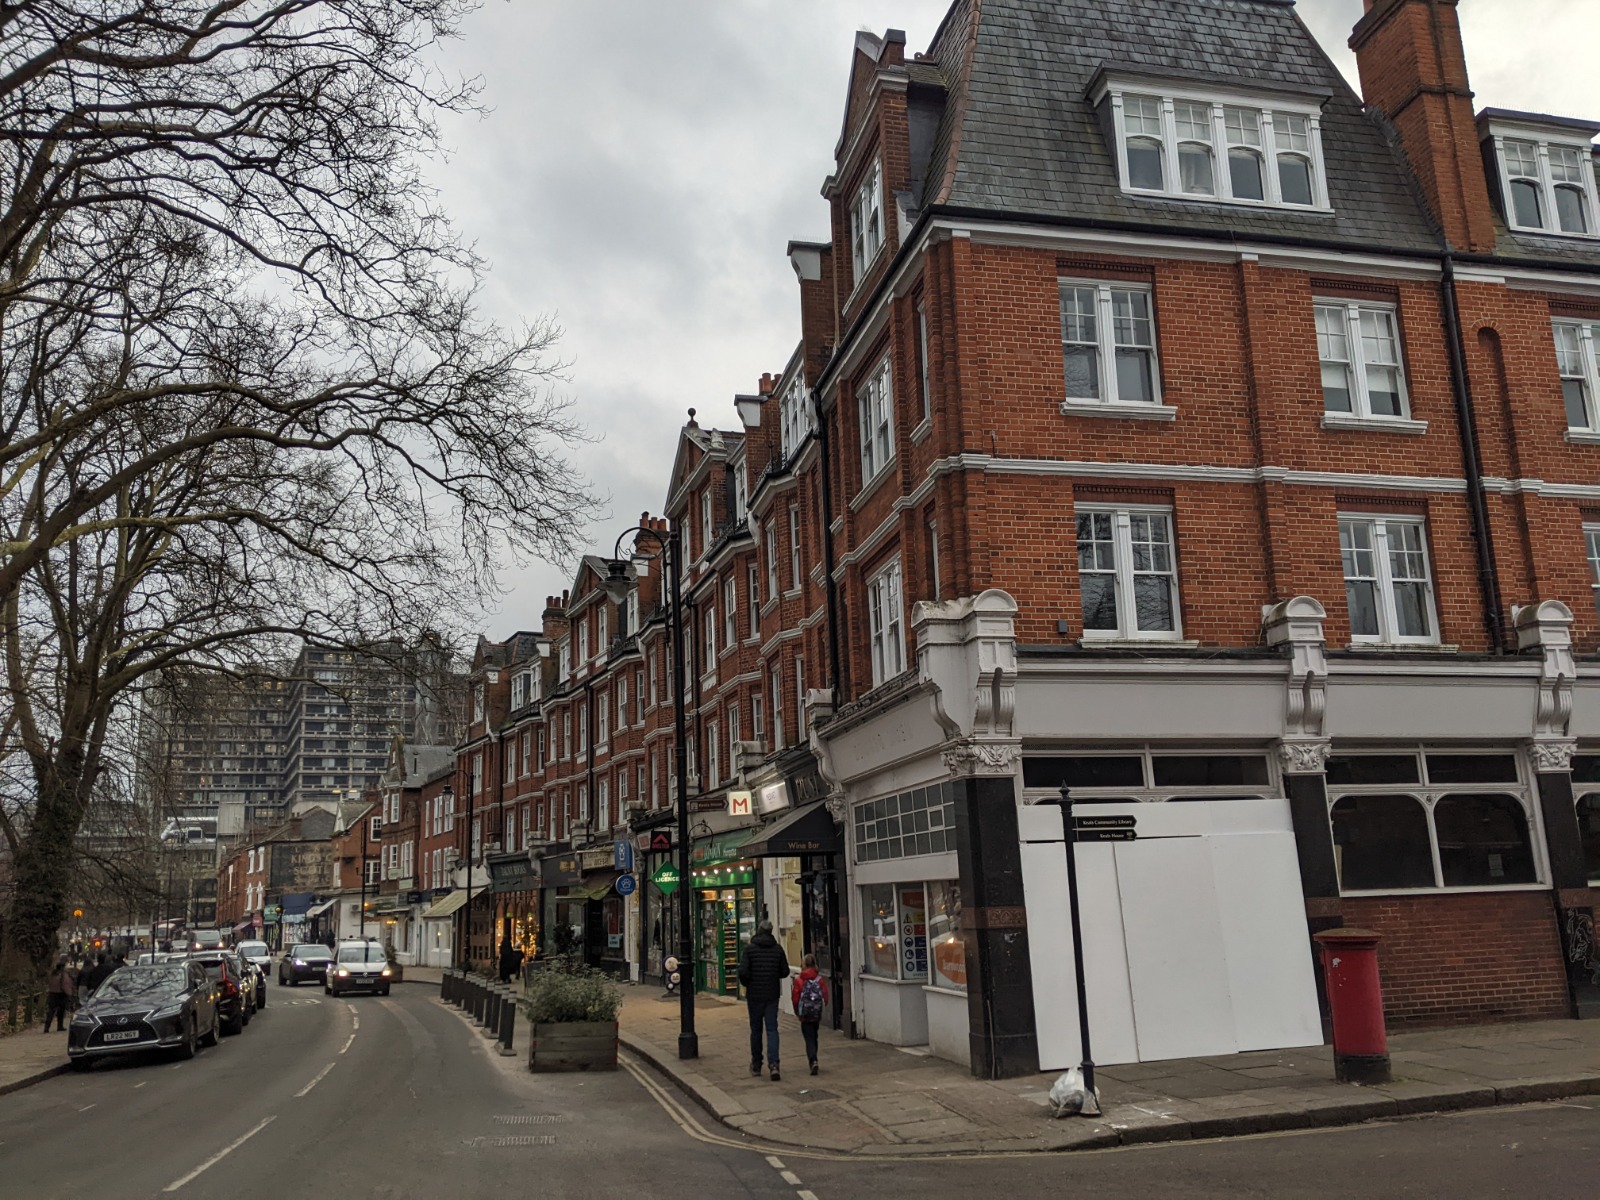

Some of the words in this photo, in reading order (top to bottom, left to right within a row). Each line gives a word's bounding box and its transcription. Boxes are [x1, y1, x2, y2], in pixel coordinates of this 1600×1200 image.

[732, 798, 749, 814] M
[787, 841, 806, 849] Wine
[807, 841, 820, 849] Bar
